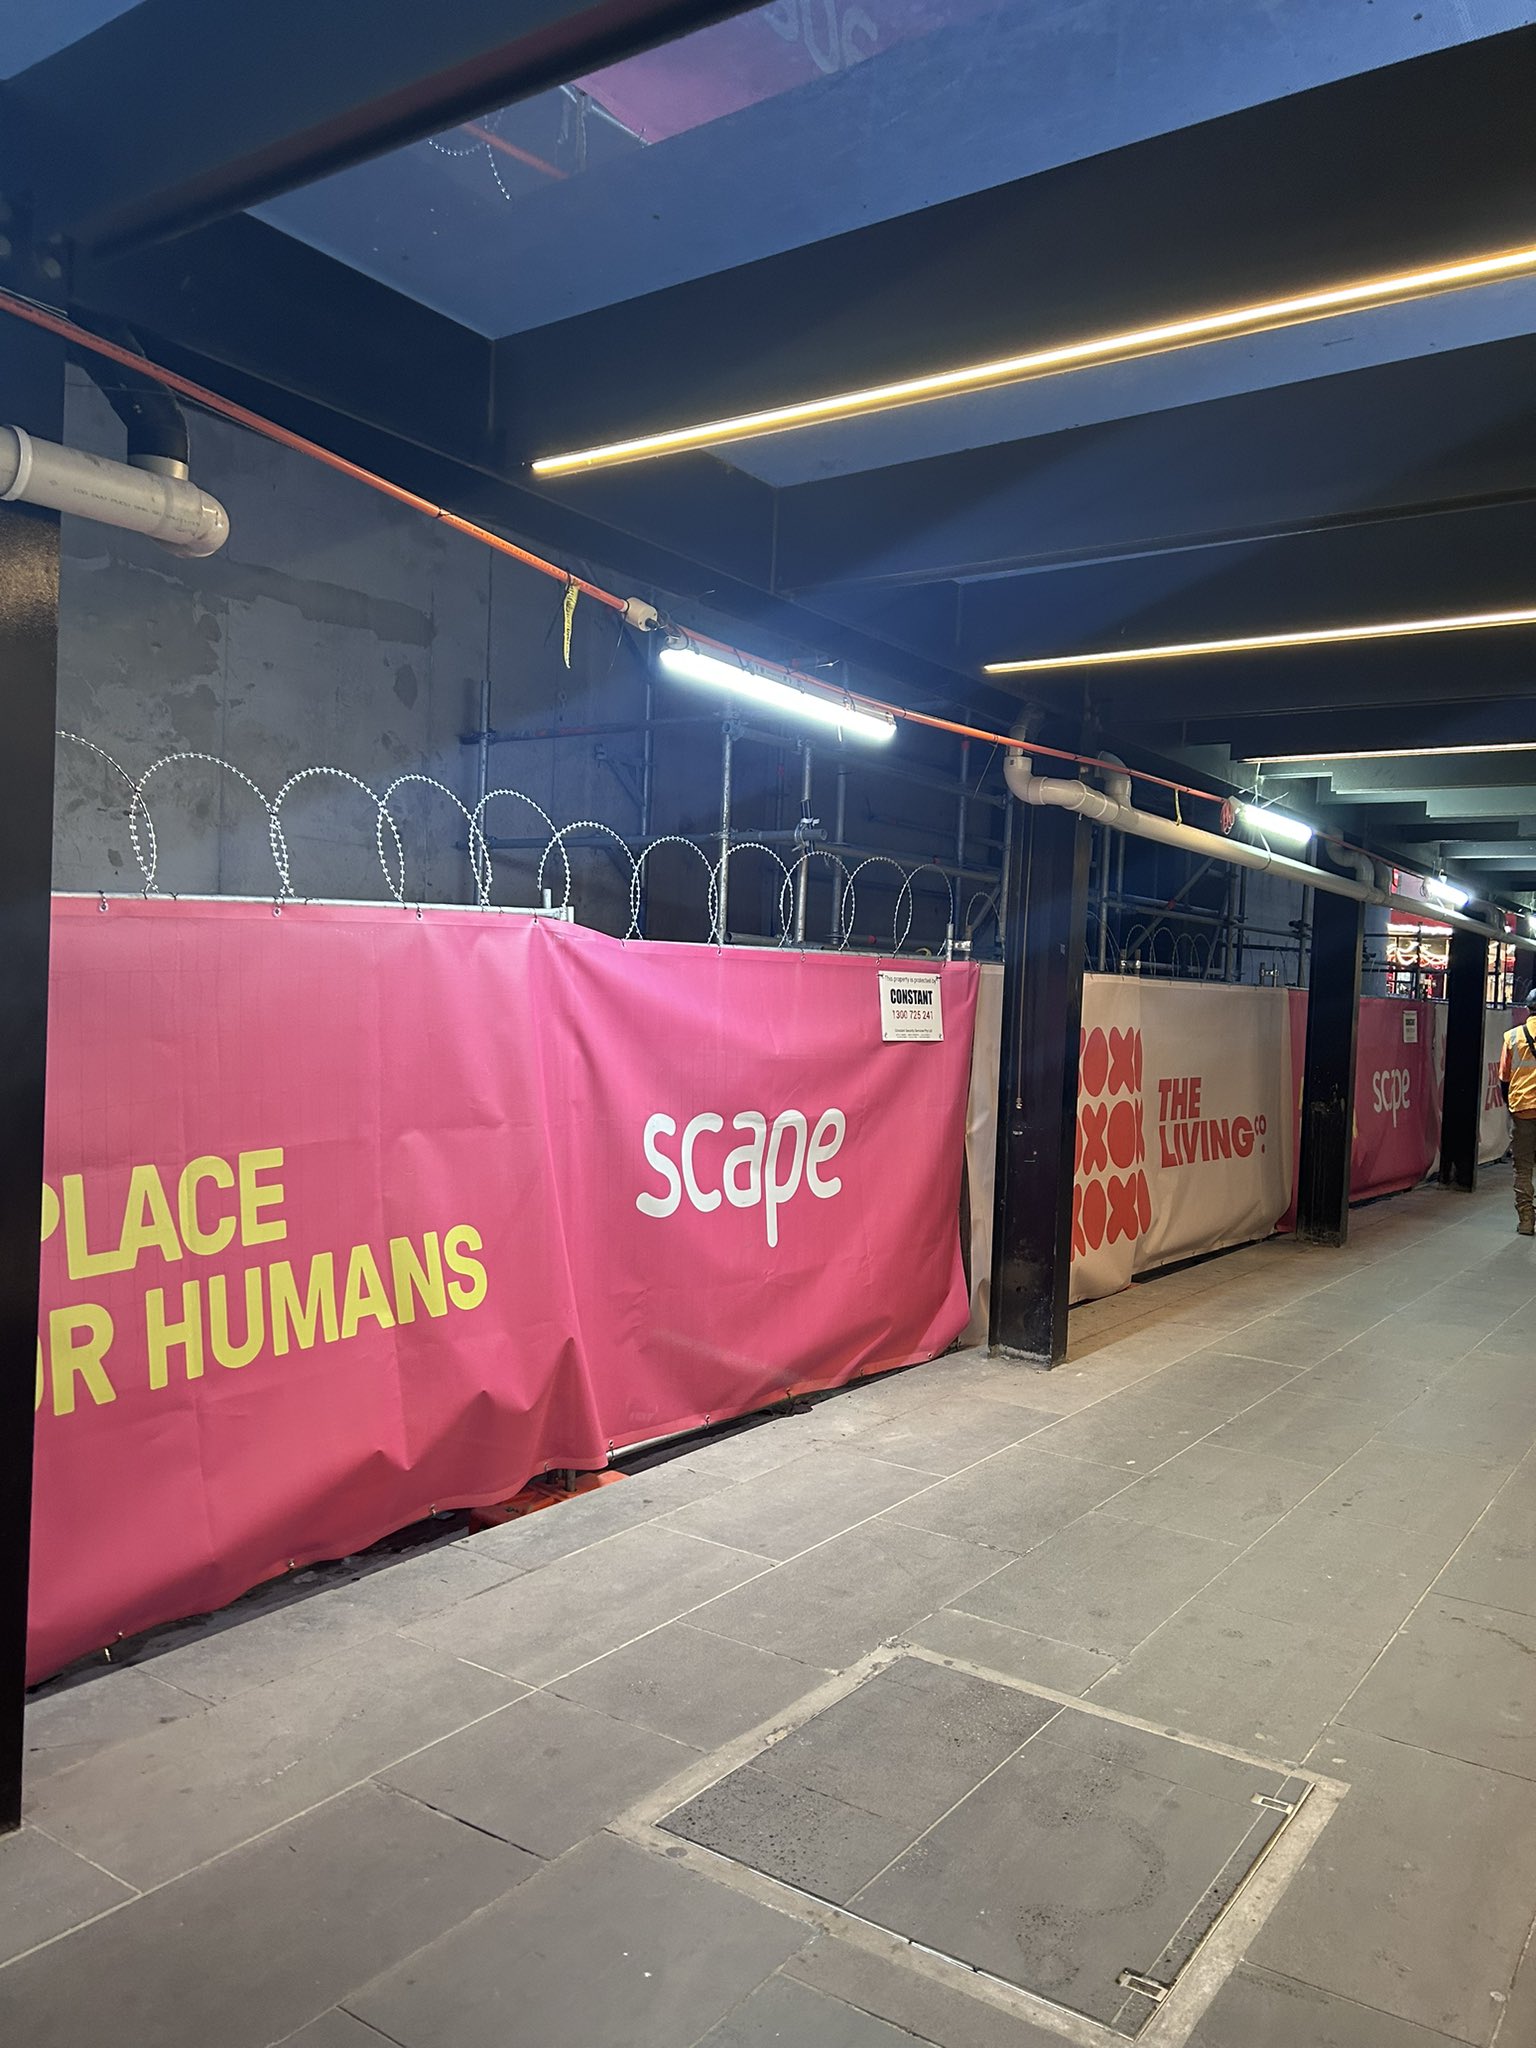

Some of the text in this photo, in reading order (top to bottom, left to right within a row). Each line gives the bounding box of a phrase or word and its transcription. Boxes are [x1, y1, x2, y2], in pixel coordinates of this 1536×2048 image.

[890, 988, 933, 1005] CONSTANT
[892, 1009, 934, 1020] 1300 725 241
[1158, 1077, 1202, 1122] THE
[1158, 1115, 1255, 1168] LIVING
[635, 1107, 846, 1248] scape
[145, 1224, 489, 1391] HUMANS
